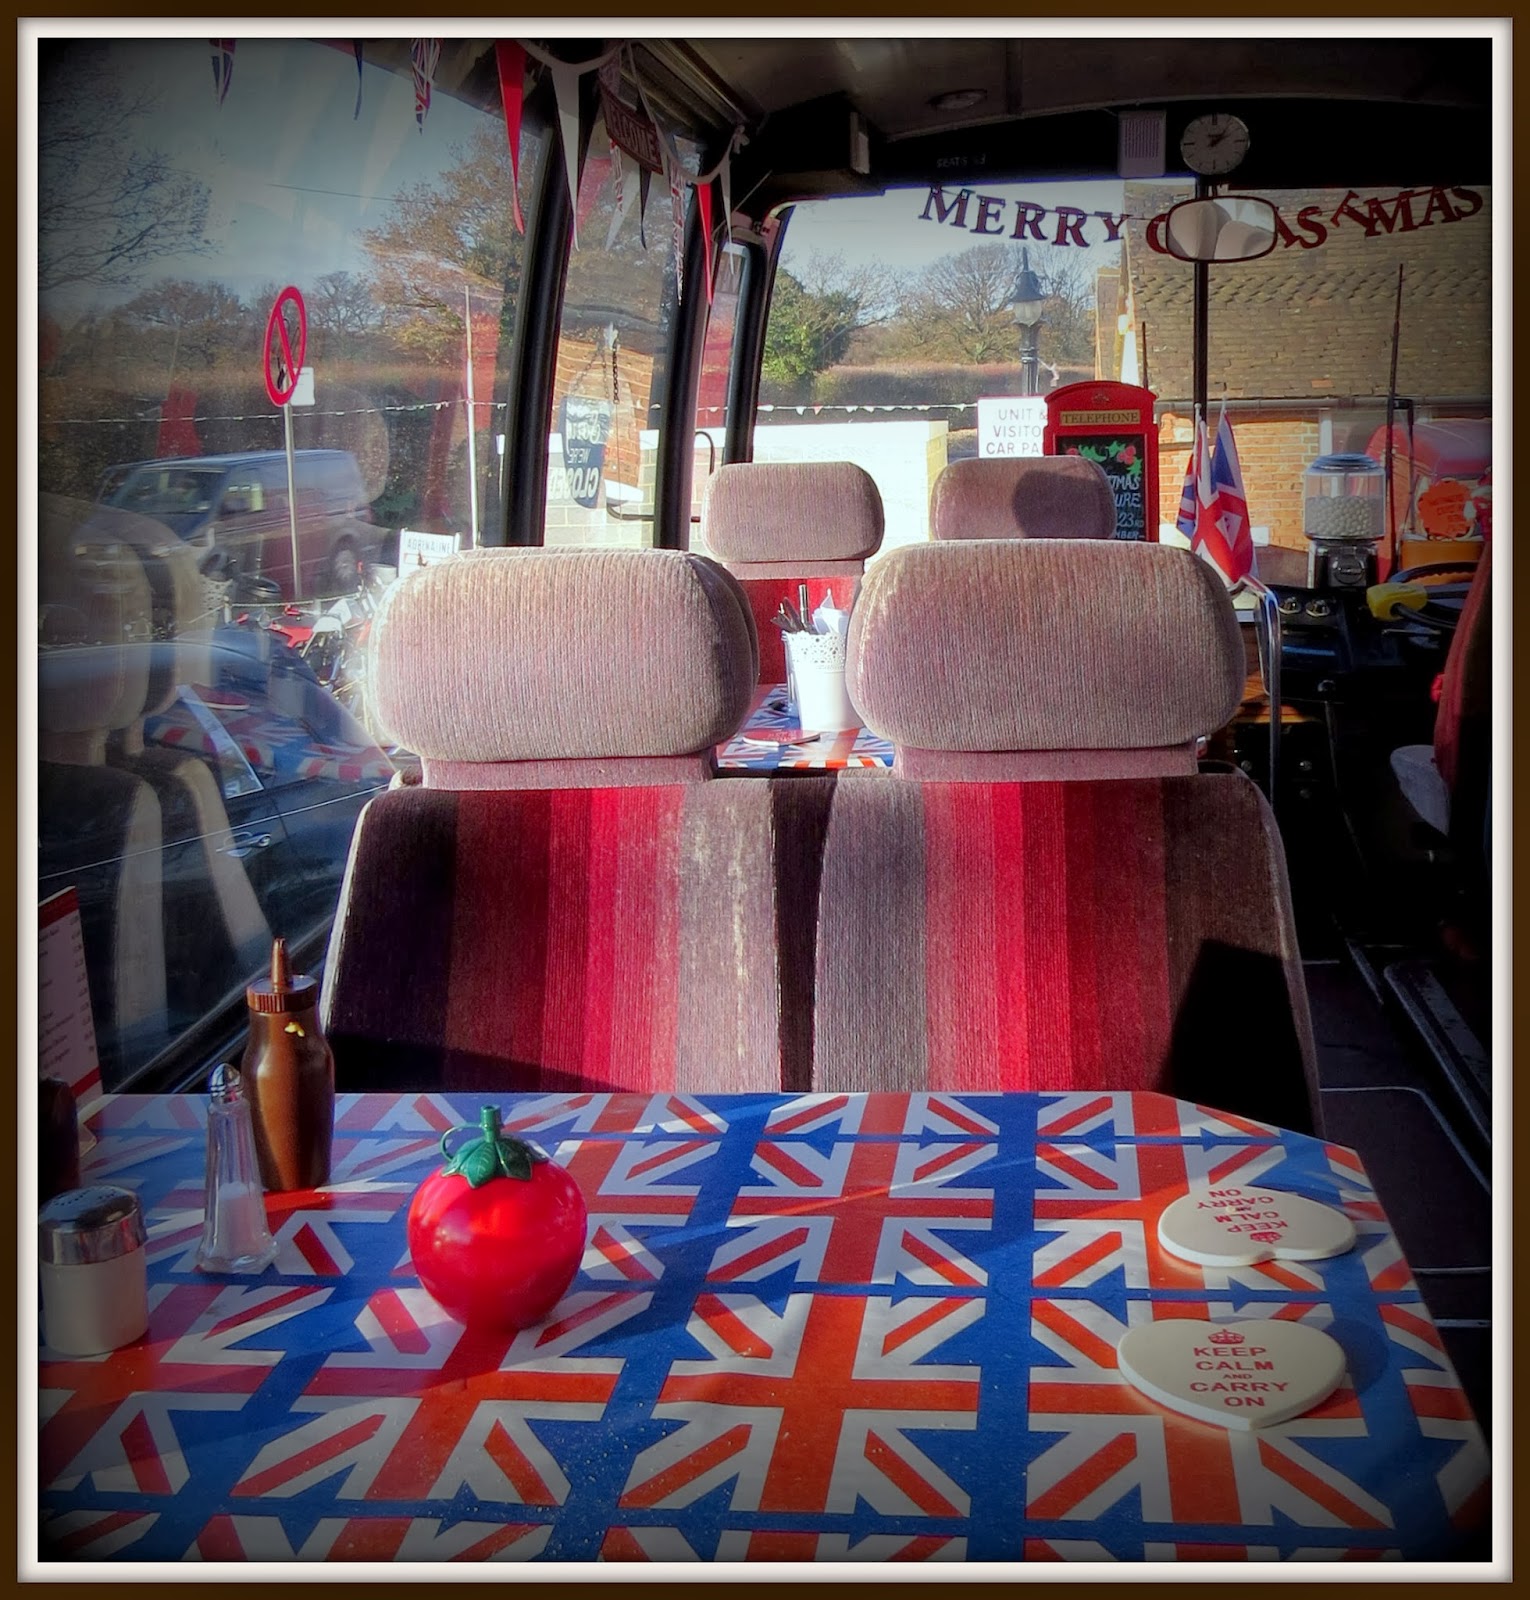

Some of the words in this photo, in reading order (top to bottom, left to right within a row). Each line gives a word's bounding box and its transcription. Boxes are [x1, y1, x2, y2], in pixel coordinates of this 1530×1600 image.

[604, 100, 659, 167] ELCOME
[918, 185, 1134, 248] MERRY
[1146, 187, 1484, 254] CISTMAS
[998, 408, 1033, 421] UNIT
[1062, 411, 1139, 424] TELEPHONE
[993, 426, 1042, 438] VISITO
[986, 442, 1016, 456] CAR
[1022, 442, 1040, 455] PA
[1107, 473, 1142, 491] TMAS
[1114, 492, 1142, 507] URE
[1208, 1188, 1241, 1198] ON
[1197, 1195, 1274, 1209] CARRY
[1214, 1210, 1279, 1223] CALM
[1227, 1220, 1288, 1233] KEEP
[1193, 1346, 1267, 1357] KEEP
[1195, 1360, 1275, 1371] CALM
[1189, 1382, 1290, 1392] CARRY
[1223, 1396, 1266, 1407] ON
